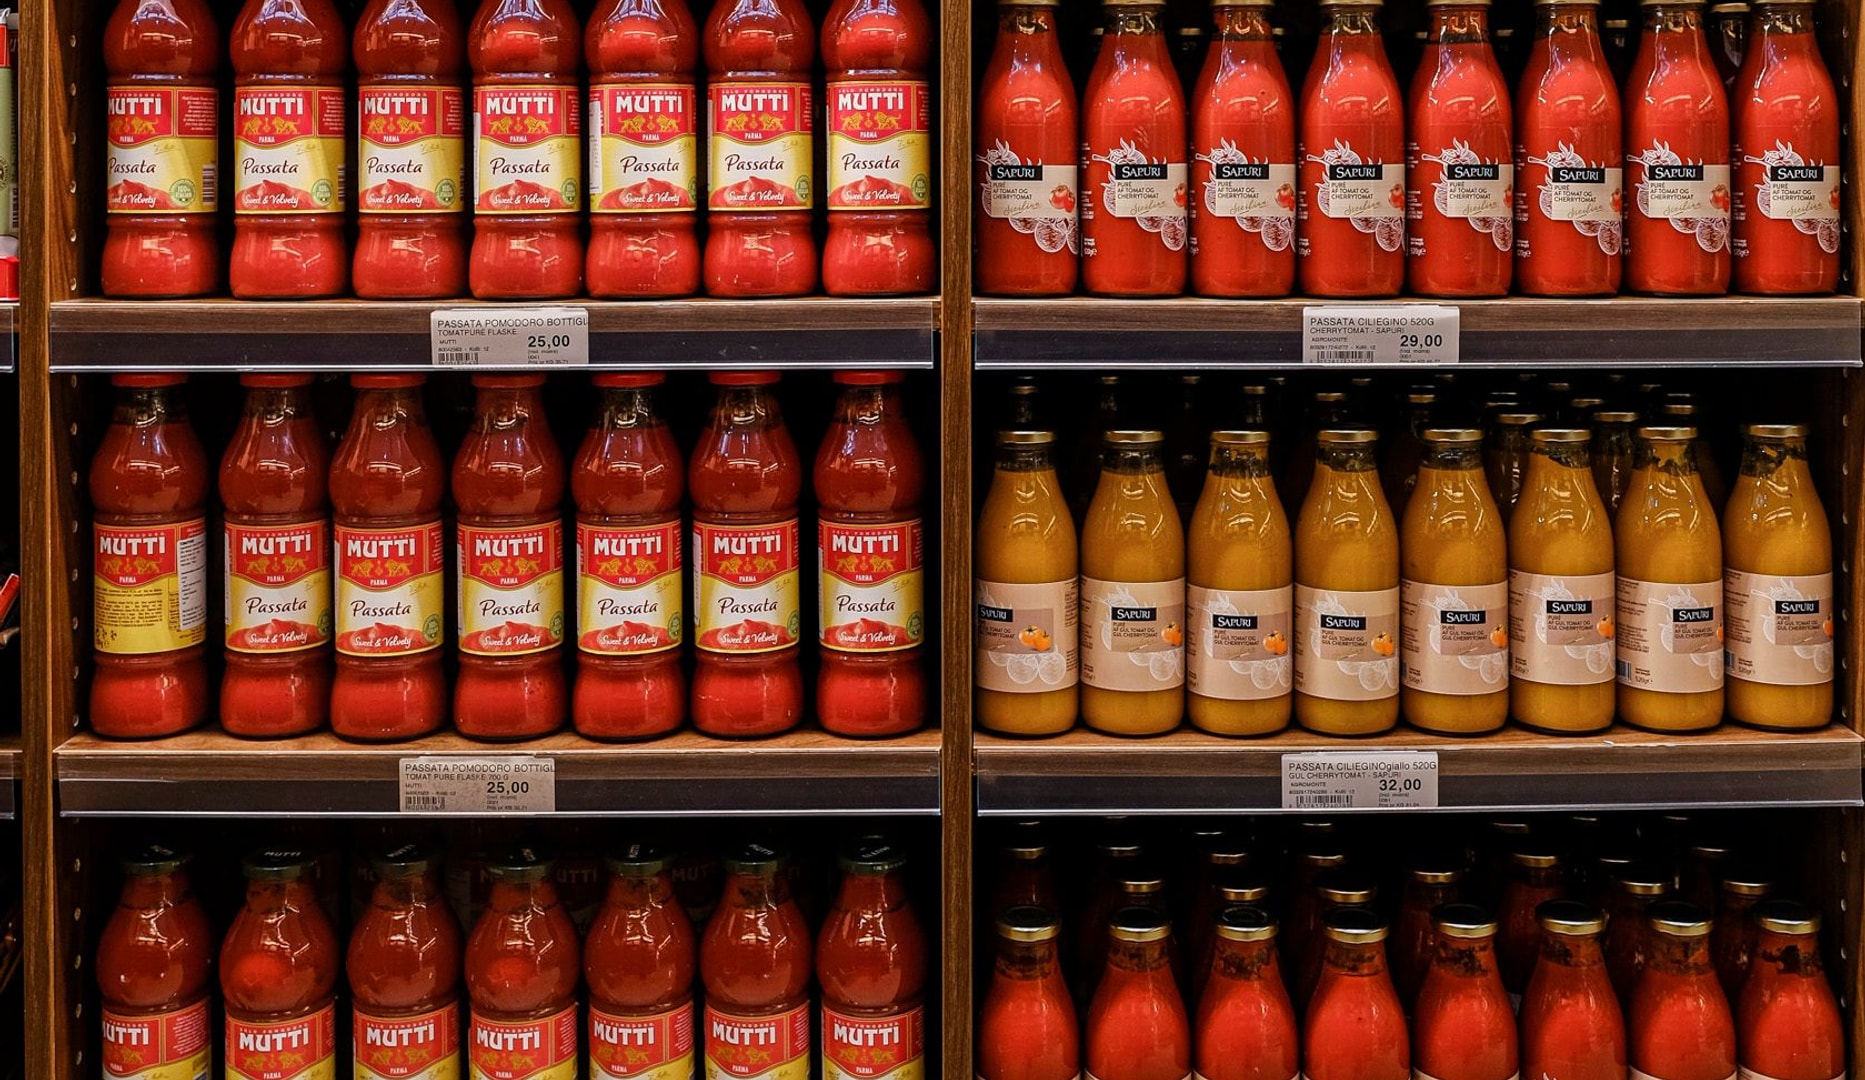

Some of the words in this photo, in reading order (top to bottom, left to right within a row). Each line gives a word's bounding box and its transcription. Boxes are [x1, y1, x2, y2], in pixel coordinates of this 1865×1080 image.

[240, 98, 303, 115] MUTTI
[365, 97, 427, 114] MUTTI
[487, 97, 553, 114] MUTTI
[616, 95, 682, 113] MUTTI
[722, 92, 788, 111] MUTTI
[838, 92, 904, 110] MUTTI
[242, 158, 298, 175] Passata
[366, 157, 423, 174] Passata
[490, 158, 550, 175] Passata
[620, 155, 680, 173] Passata
[725, 153, 784, 171] Passata
[842, 153, 900, 170] Passata
[997, 167, 1034, 178] SAPURI
[1122, 166, 1160, 178] SAPURI
[1222, 166, 1261, 178] SAPURI
[1336, 167, 1375, 178] SAPURI
[1454, 166, 1492, 178] SAPURI
[1561, 169, 1599, 181] SAPURI
[1655, 167, 1696, 179] SAPURI
[1778, 168, 1817, 179] SAPURI
[122, 195, 127, 204] &
[128, 193, 156, 208] Velvety
[245, 194, 261, 204] Sweet
[262, 195, 268, 204] &
[270, 193, 298, 208] Velvety
[367, 194, 385, 204] Sweet
[386, 194, 392, 204] &
[394, 193, 423, 207] Velvety
[493, 194, 513, 204] Sweet
[515, 194, 521, 204] &
[523, 193, 551, 208] Velvety
[623, 193, 645, 204] Sweet
[647, 193, 654, 203] &
[656, 191, 680, 206] Velvety
[728, 191, 748, 201] Sweet
[750, 191, 756, 201] &
[758, 190, 784, 205] Velvety
[844, 191, 866, 201] Sweet
[867, 191, 873, 200] &
[875, 189, 900, 204] Velvety
[438, 319, 482, 328] PASSATA
[485, 319, 544, 327] POMODORO
[547, 317, 587, 326] BOTTIGL
[528, 335, 569, 349] 25,00
[1400, 335, 1442, 348] 29,00
[100, 537, 165, 555] MUTTI
[243, 535, 311, 555] MUTTI
[348, 538, 415, 558] MUTTI
[476, 537, 543, 556] MUTTI
[594, 537, 661, 555] MUTTI
[714, 535, 780, 554] MUTTI
[832, 534, 898, 553] MUTTI
[246, 597, 307, 614] Passata
[351, 600, 412, 617] Passata
[480, 600, 540, 616] Passata
[598, 598, 657, 615] Passata
[718, 597, 778, 614] Passata
[836, 595, 896, 612] Passata
[1553, 602, 1586, 612] SAPURI
[1781, 602, 1814, 612] SAPURI
[981, 608, 1006, 620] SAPURI
[1117, 609, 1150, 619] SAPURI
[1447, 612, 1480, 622] SAPURI
[1679, 610, 1709, 621] SAPURI
[1218, 617, 1251, 627] SAPURI
[1326, 617, 1359, 627] SAPURI
[250, 633, 270, 644] Sweet
[271, 634, 277, 643] &
[279, 631, 308, 644] Velvety
[354, 636, 373, 646] Sweet
[375, 637, 381, 646] &
[383, 635, 411, 648] Velvety
[484, 635, 504, 646] Sweet
[506, 636, 511, 645] &
[514, 634, 541, 646] Velvety
[601, 635, 621, 645] Sweet
[623, 636, 629, 645] &
[632, 634, 658, 646] Velvety
[722, 633, 742, 644] Sweet
[744, 635, 750, 644] &
[752, 633, 778, 645] Velvety
[840, 632, 858, 642] Sweet
[860, 633, 866, 642] &
[868, 632, 896, 645] Velvety
[1337, 763, 1410, 771] CILIEGINOgiallo
[487, 782, 529, 795] 25,00
[1379, 779, 1421, 792] 32,00
[239, 1027, 309, 1051] MUTTI
[367, 1024, 434, 1046] MUTTI
[477, 1027, 540, 1050] MUTTI
[594, 1021, 654, 1045] MUTTI
[713, 1021, 775, 1045] MUTTI
[834, 1023, 899, 1046] MUTTI
[611, 1064, 627, 1073] PARMA
[732, 1064, 748, 1073] PARMA
[856, 1066, 873, 1074] PARMA
